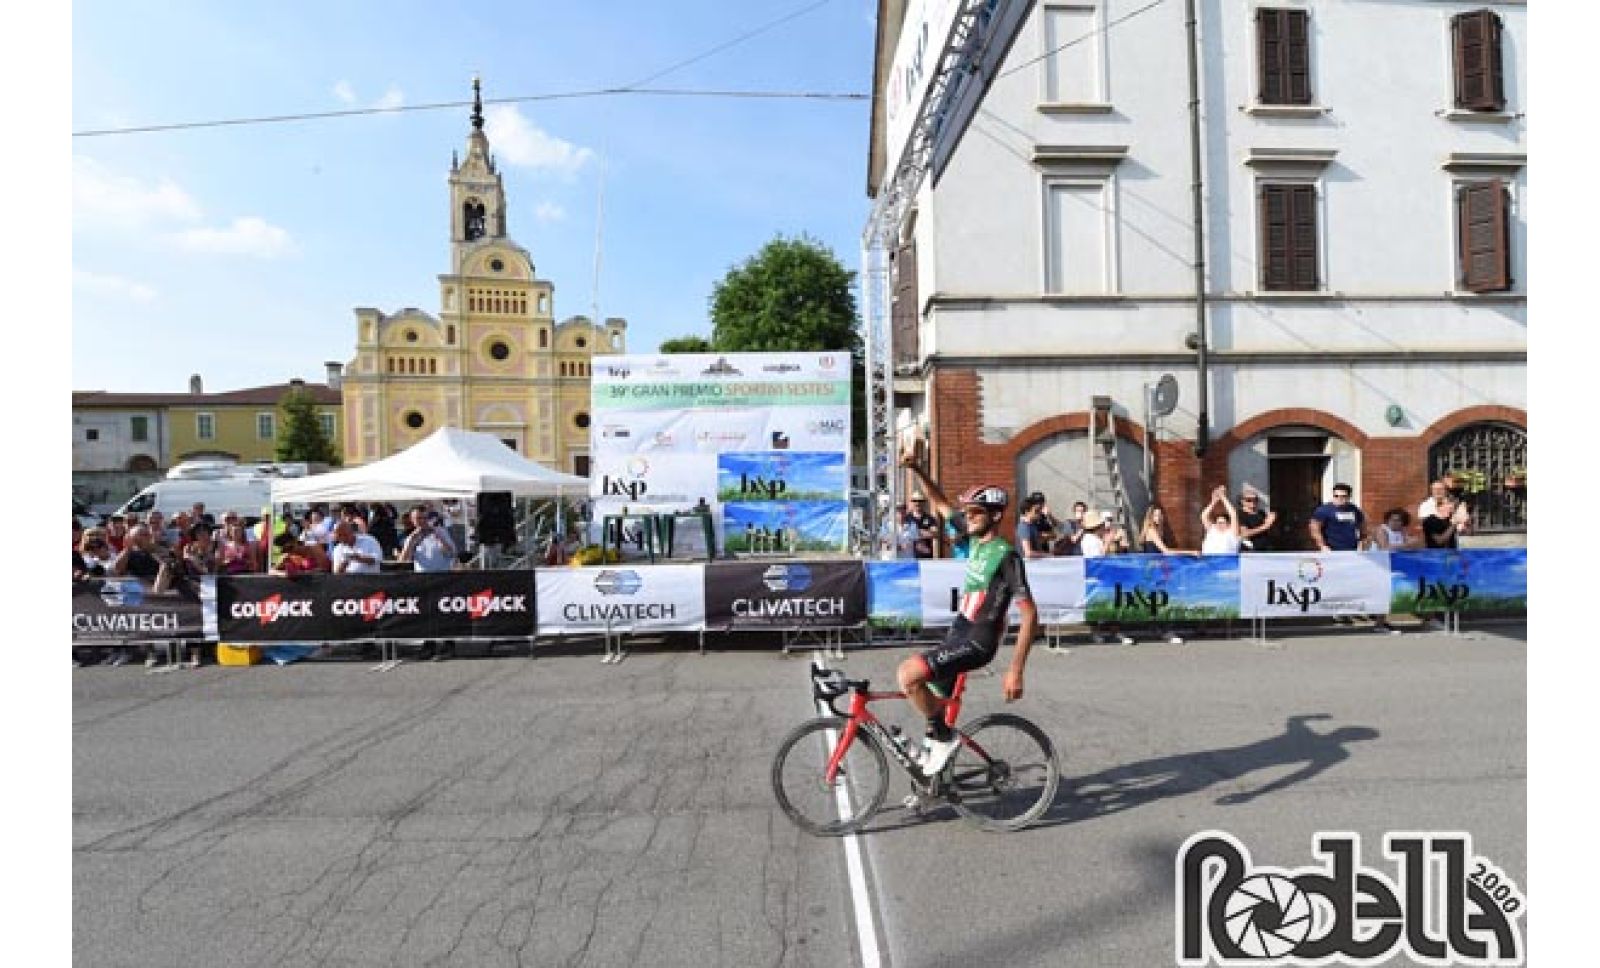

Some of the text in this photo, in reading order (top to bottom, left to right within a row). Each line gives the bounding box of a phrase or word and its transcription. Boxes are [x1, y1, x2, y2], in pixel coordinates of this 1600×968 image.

[632, 385, 669, 397] GRAN
[672, 384, 722, 397] PREMIO
[724, 383, 783, 397] SPORTIVI
[787, 382, 836, 396] SESTESI
[230, 600, 313, 622] COLPACK
[331, 597, 420, 619] COLPACK
[438, 595, 526, 617] COLPACK
[563, 603, 676, 622] CLIVATECH
[731, 597, 845, 617] CLIVATECH
[73, 613, 179, 632] CLIVATECH
